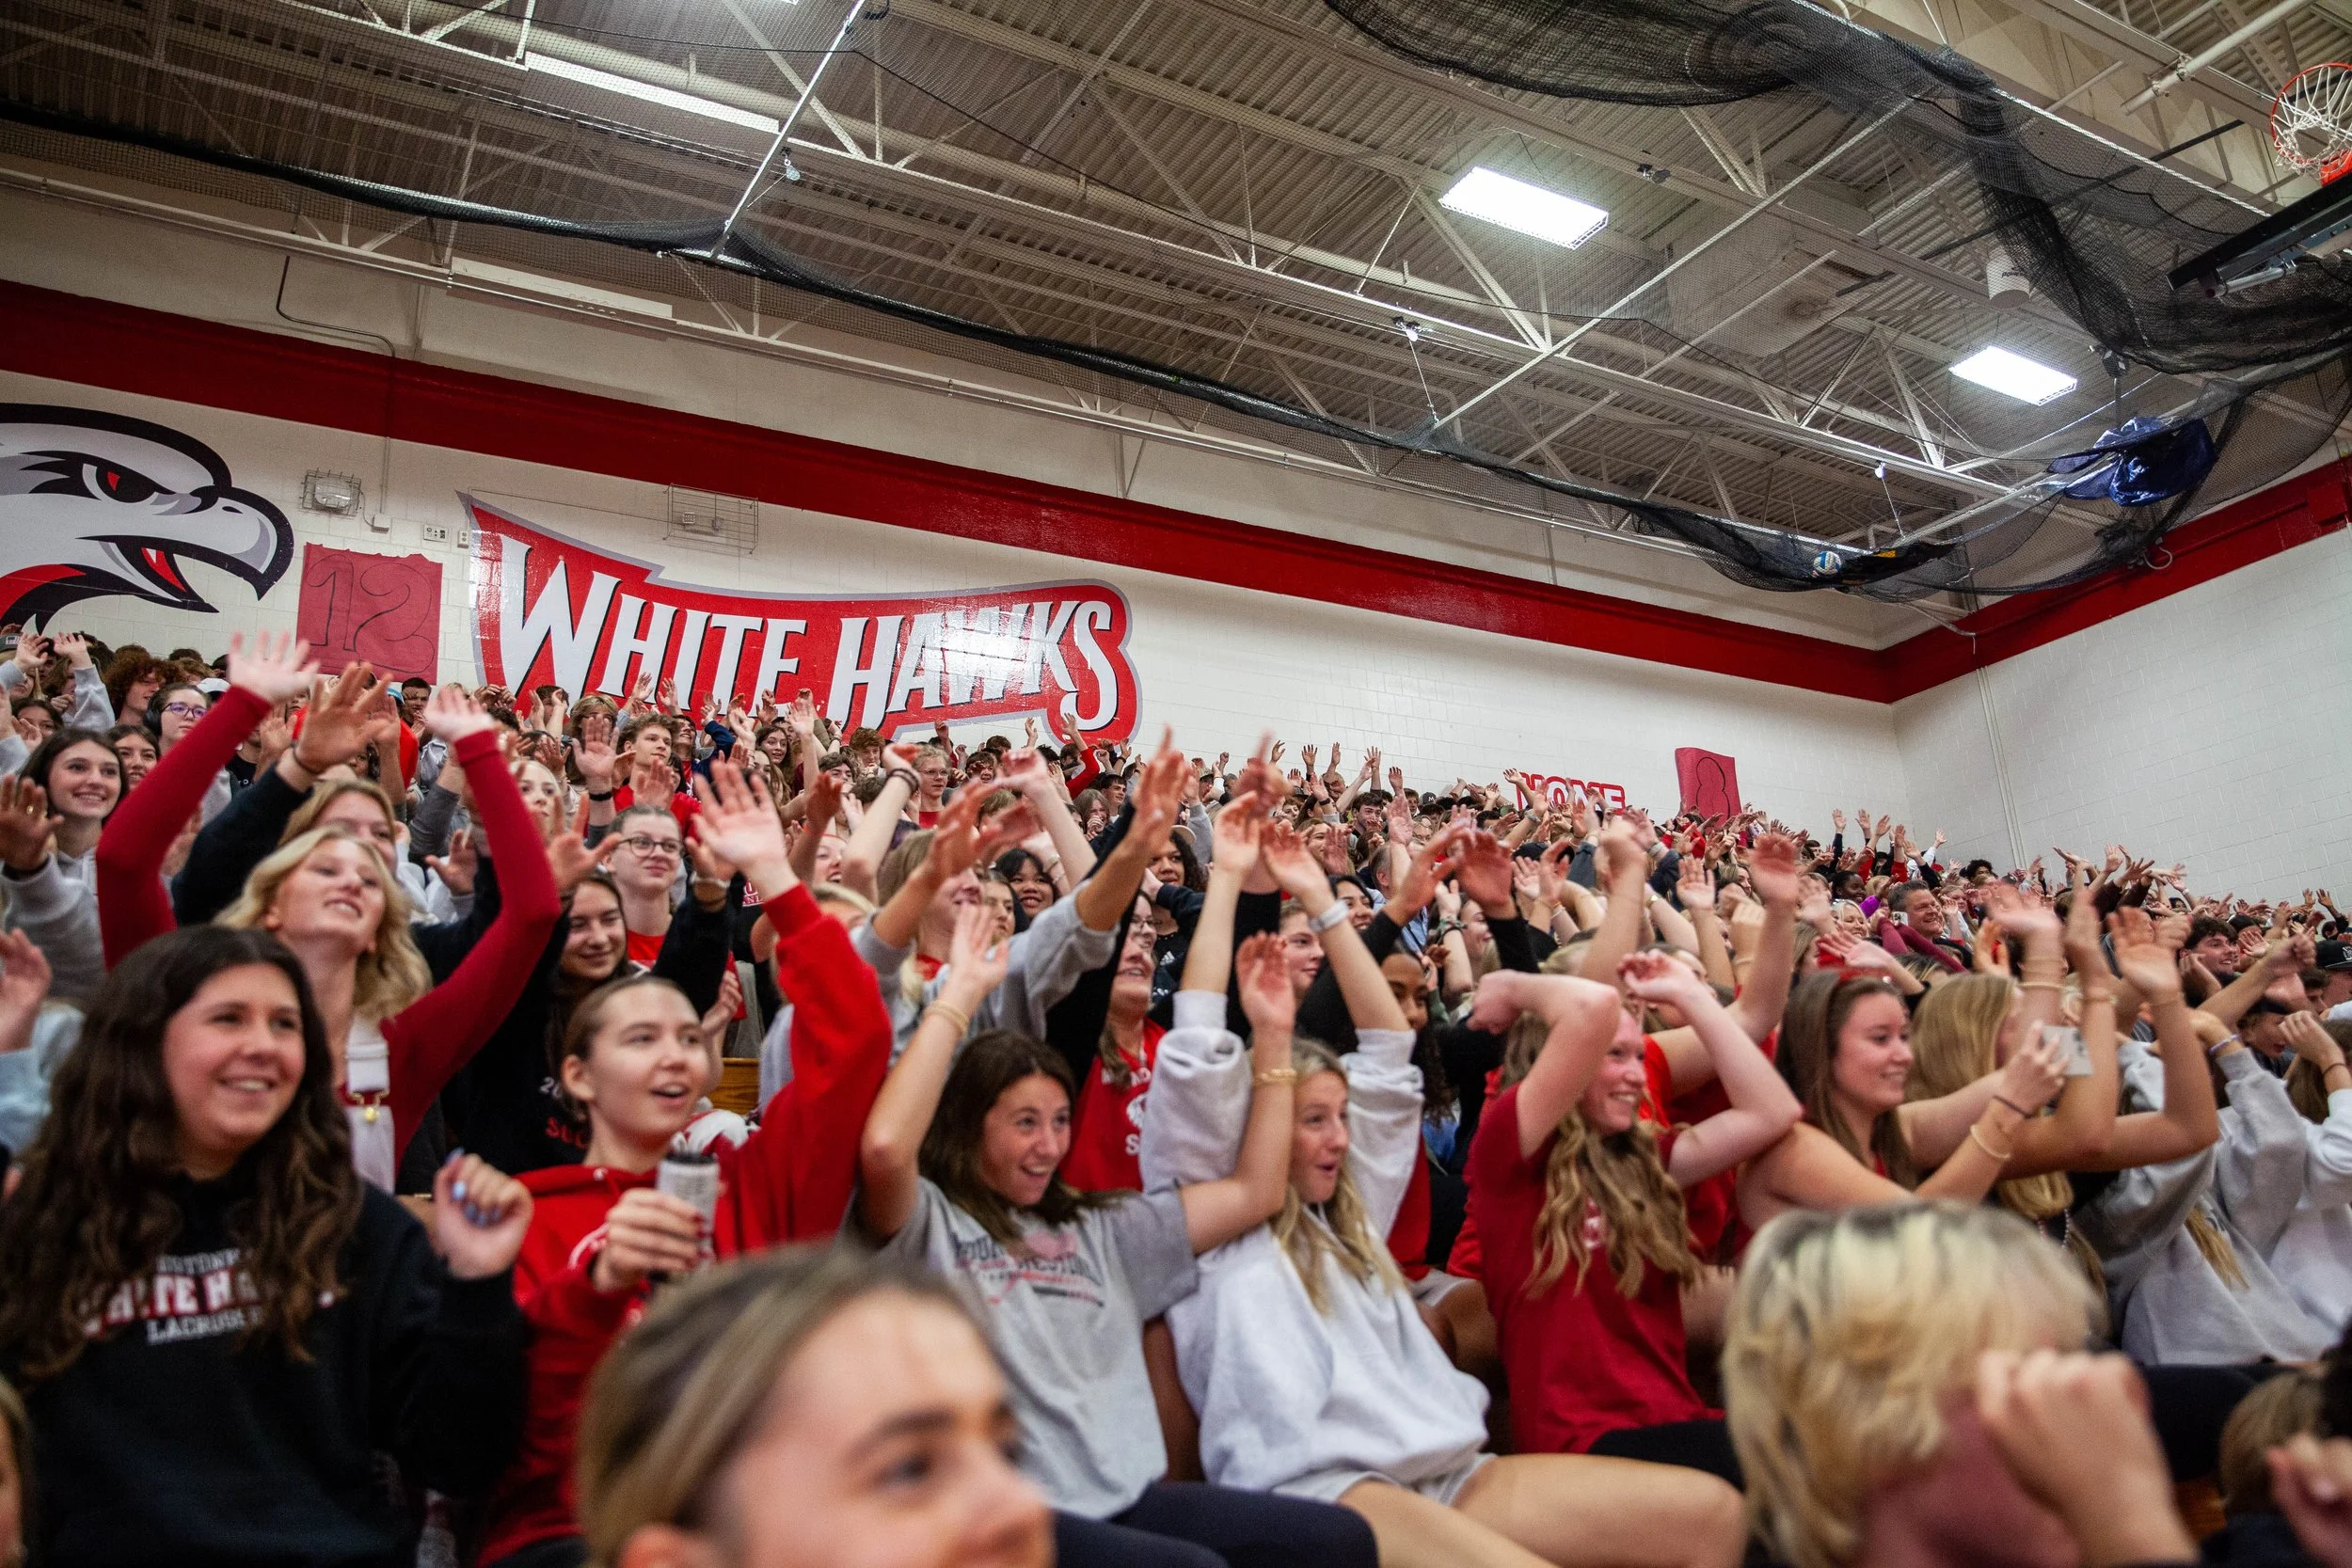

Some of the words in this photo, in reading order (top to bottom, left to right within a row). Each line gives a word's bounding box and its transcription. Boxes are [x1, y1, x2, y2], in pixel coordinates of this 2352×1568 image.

[306, 553, 436, 674] 12
[499, 531, 808, 720] WHITE
[825, 599, 1120, 733] HAWKS
